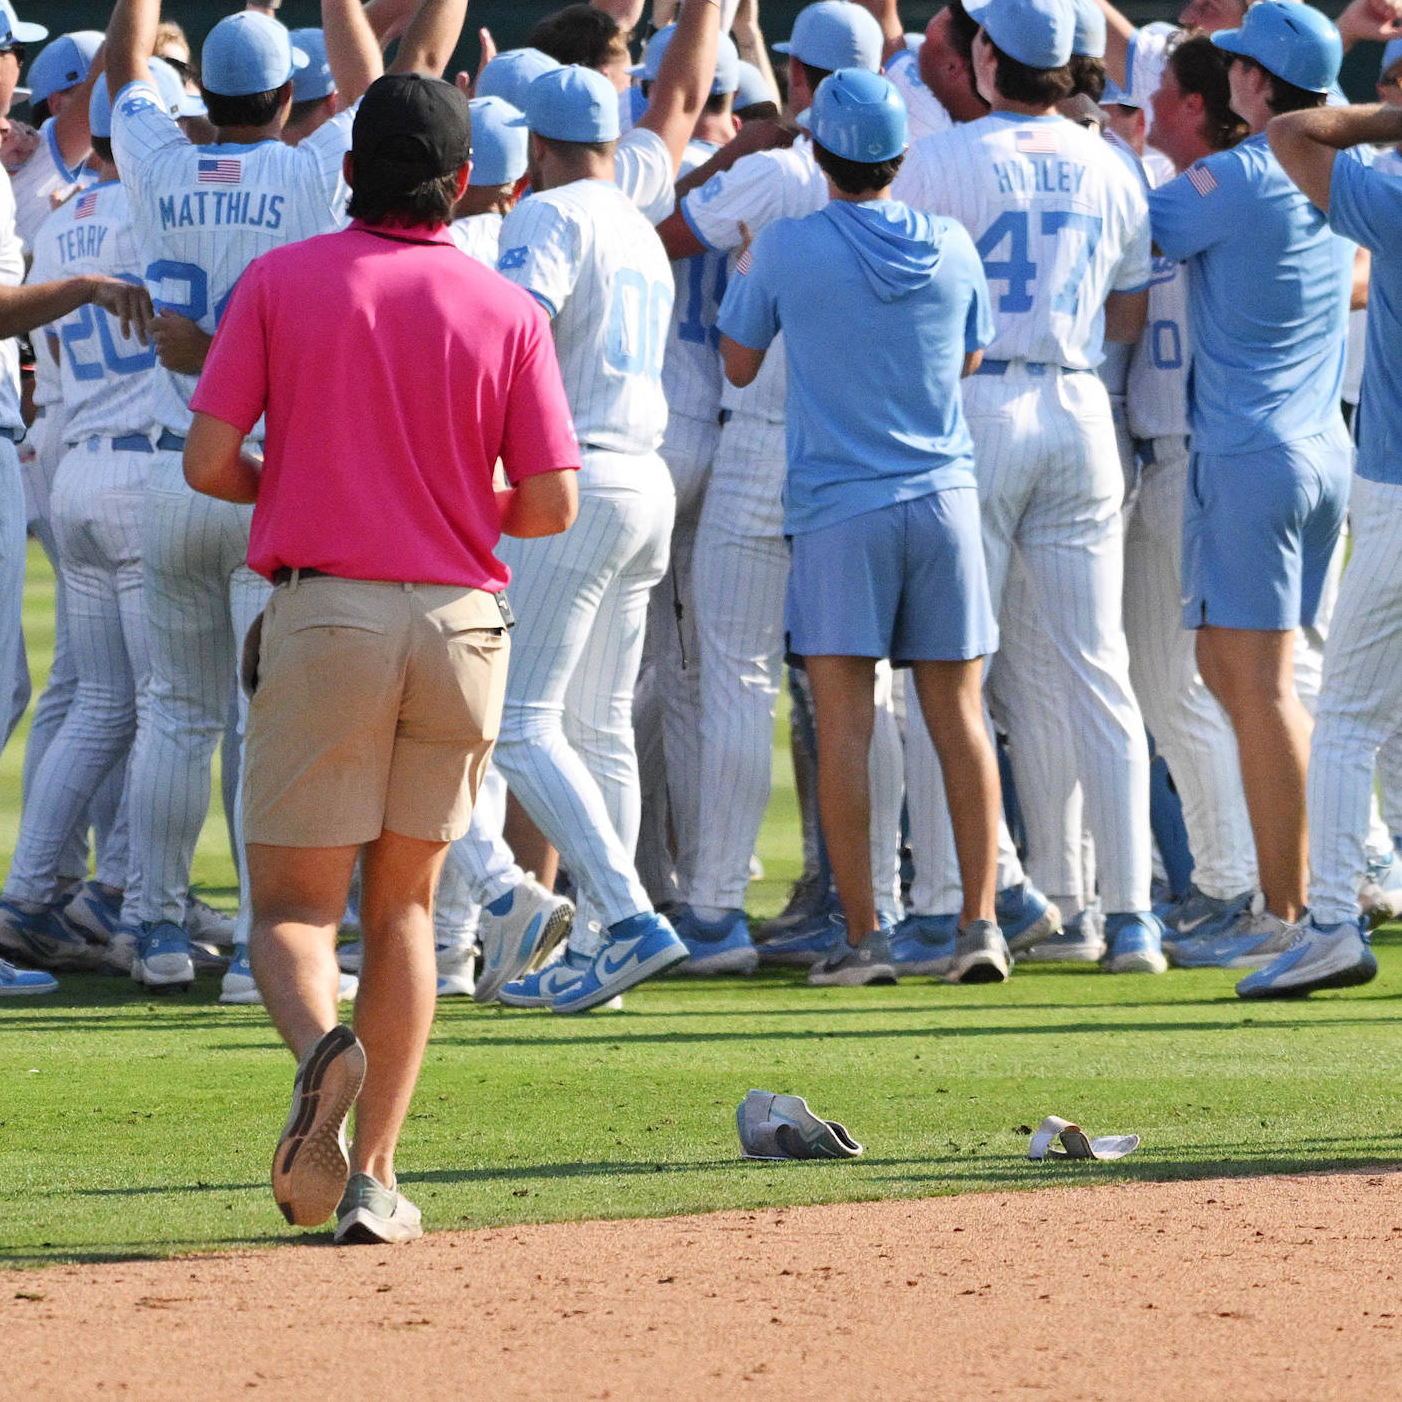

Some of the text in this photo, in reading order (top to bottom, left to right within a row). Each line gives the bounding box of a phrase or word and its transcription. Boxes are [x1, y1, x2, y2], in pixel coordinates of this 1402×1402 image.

[158, 191, 285, 231] MATTHIJS
[57, 225, 108, 263] TERRY
[975, 210, 1103, 316] 47
